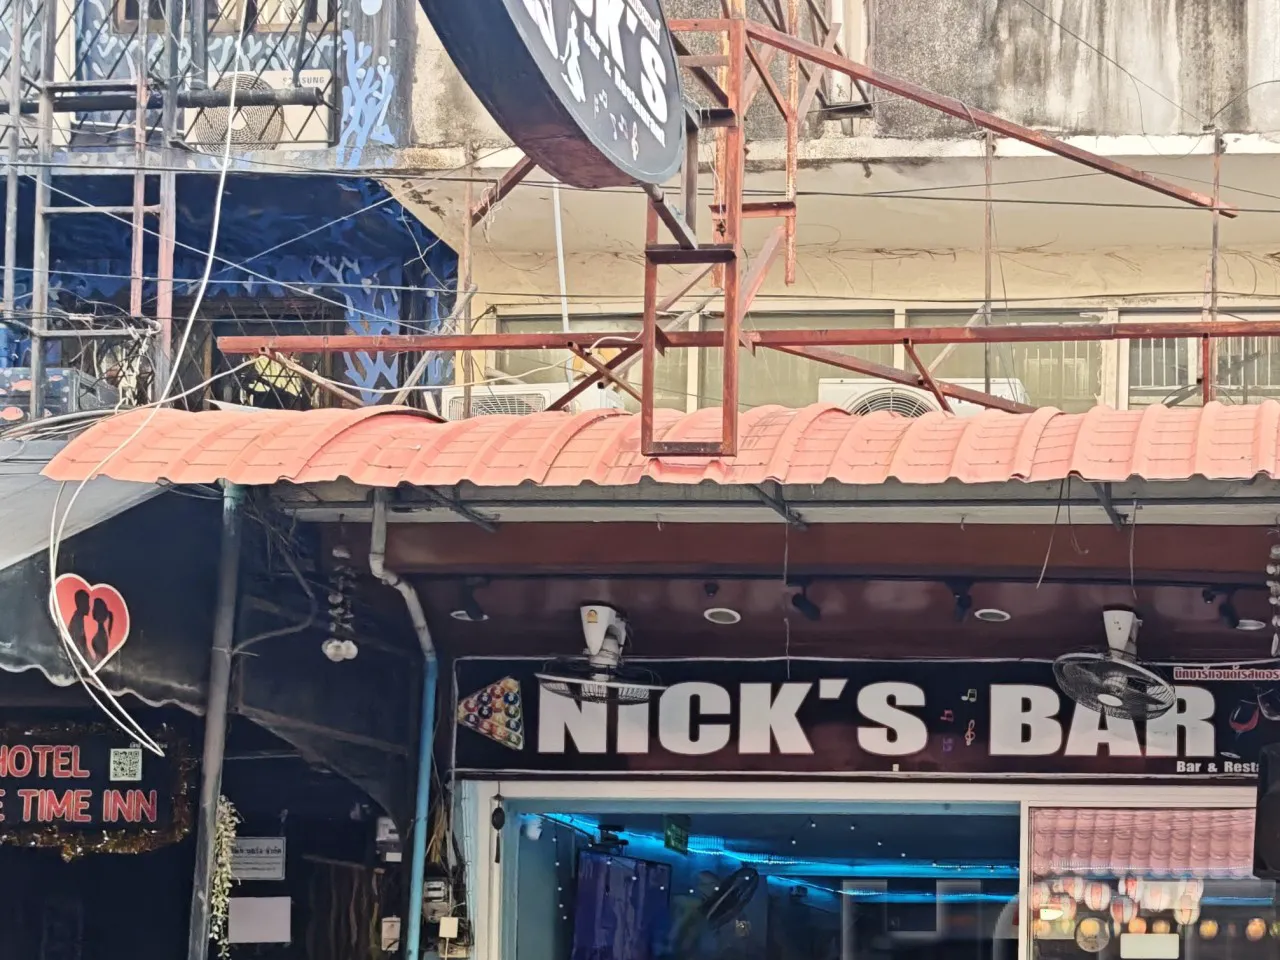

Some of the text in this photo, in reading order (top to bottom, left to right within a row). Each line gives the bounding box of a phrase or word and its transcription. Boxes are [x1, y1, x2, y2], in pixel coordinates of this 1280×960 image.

[988, 683, 1217, 757] BAR
[1176, 760, 1202, 773] Bar
[1207, 761, 1218, 773] &
[17, 788, 92, 823] TIME
[103, 789, 158, 823] INN
